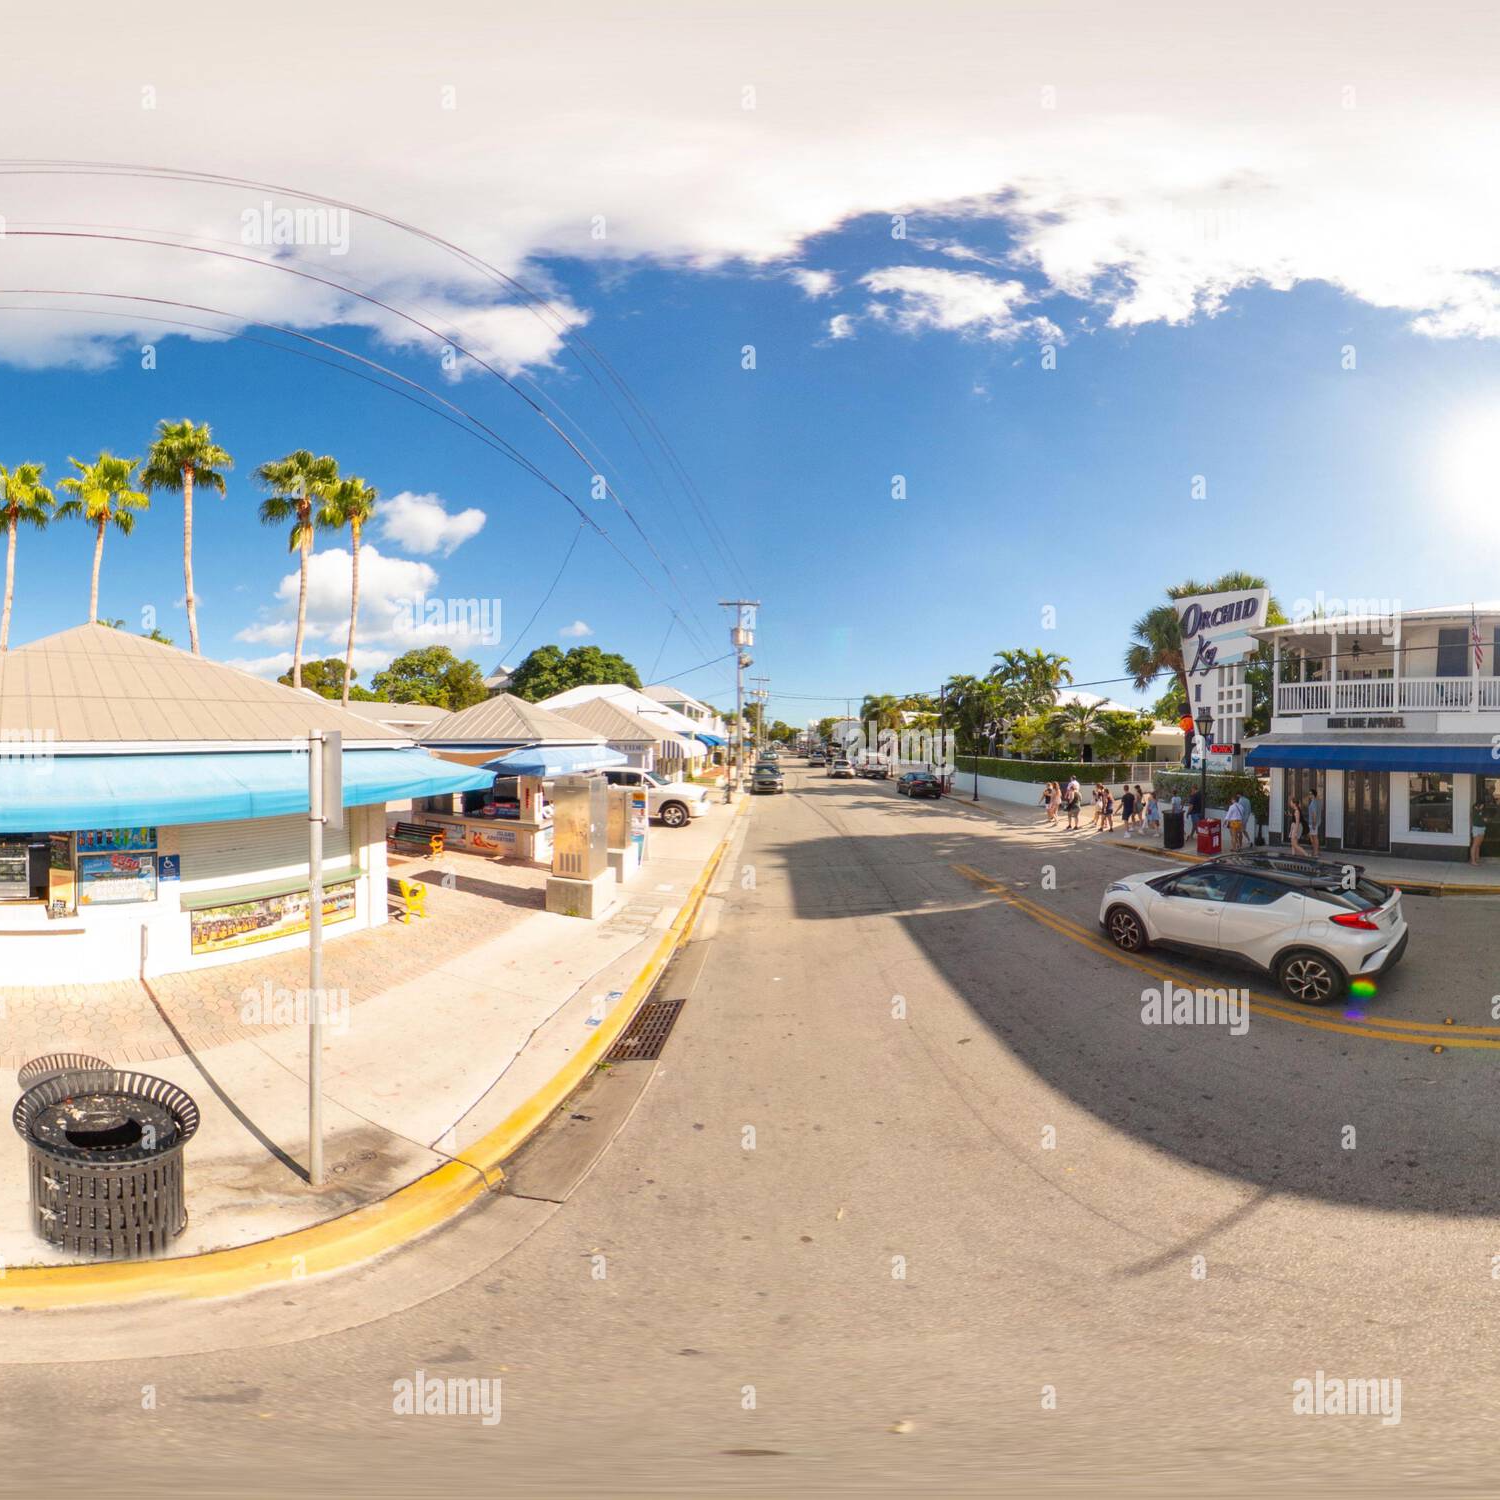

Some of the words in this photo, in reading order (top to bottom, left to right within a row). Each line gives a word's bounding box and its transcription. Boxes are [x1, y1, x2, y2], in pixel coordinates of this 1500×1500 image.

[1180, 597, 1258, 639] ORCHID
[1189, 634, 1219, 677] Key
[1367, 717, 1406, 729] APPAREL
